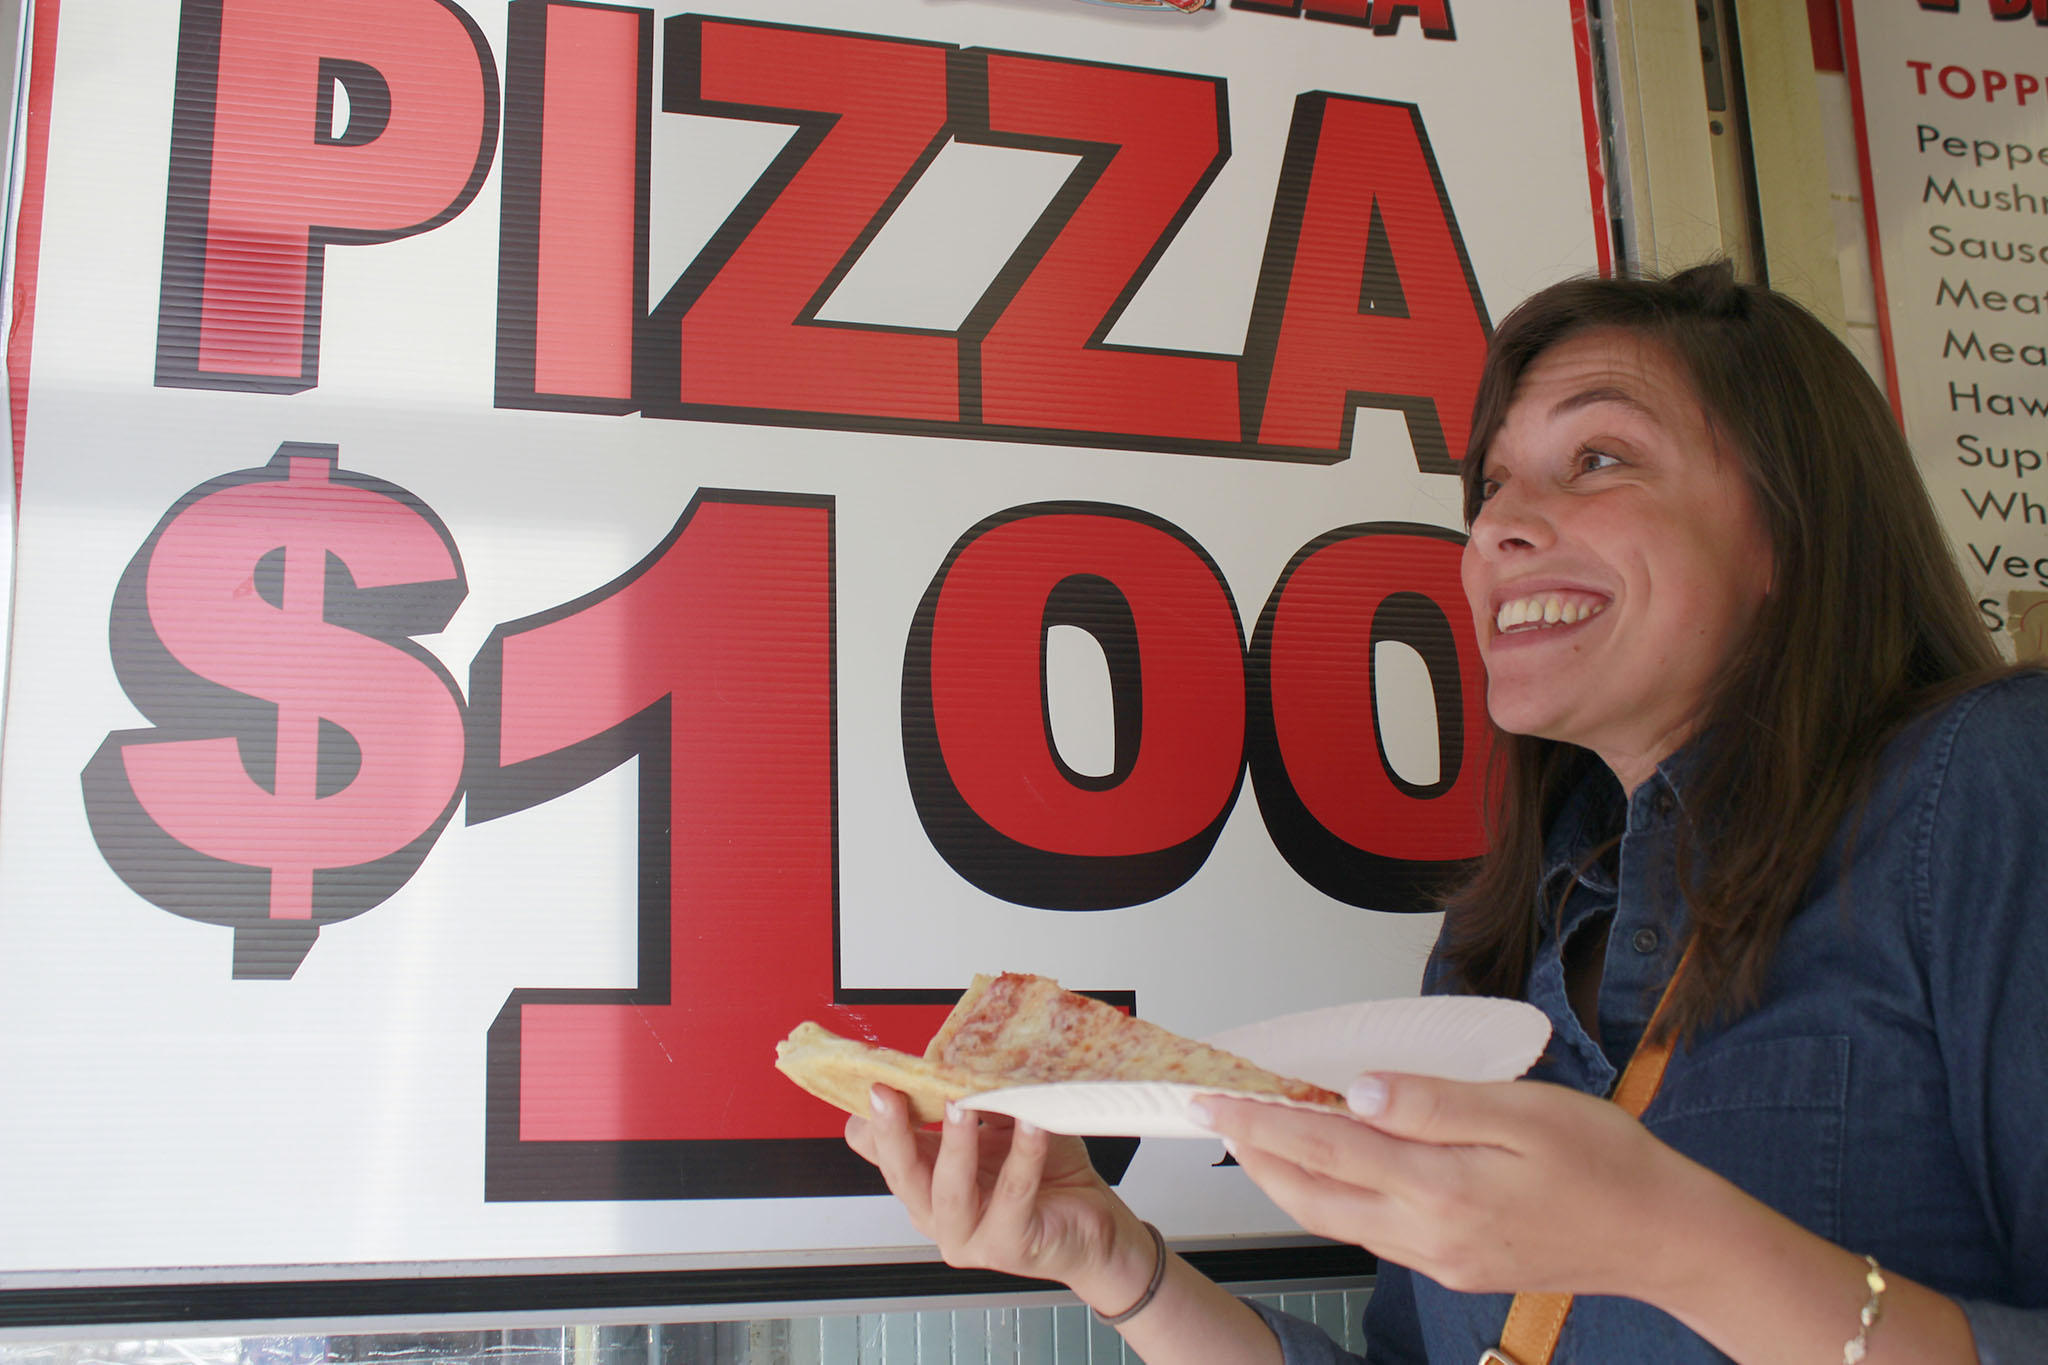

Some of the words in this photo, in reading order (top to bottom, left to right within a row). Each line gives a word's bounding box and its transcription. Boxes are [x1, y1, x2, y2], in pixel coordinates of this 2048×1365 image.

[1906, 60, 2048, 108] TOPP
[155, 0, 1494, 474] PIZZA
[1956, 434, 2048, 479] Sup
